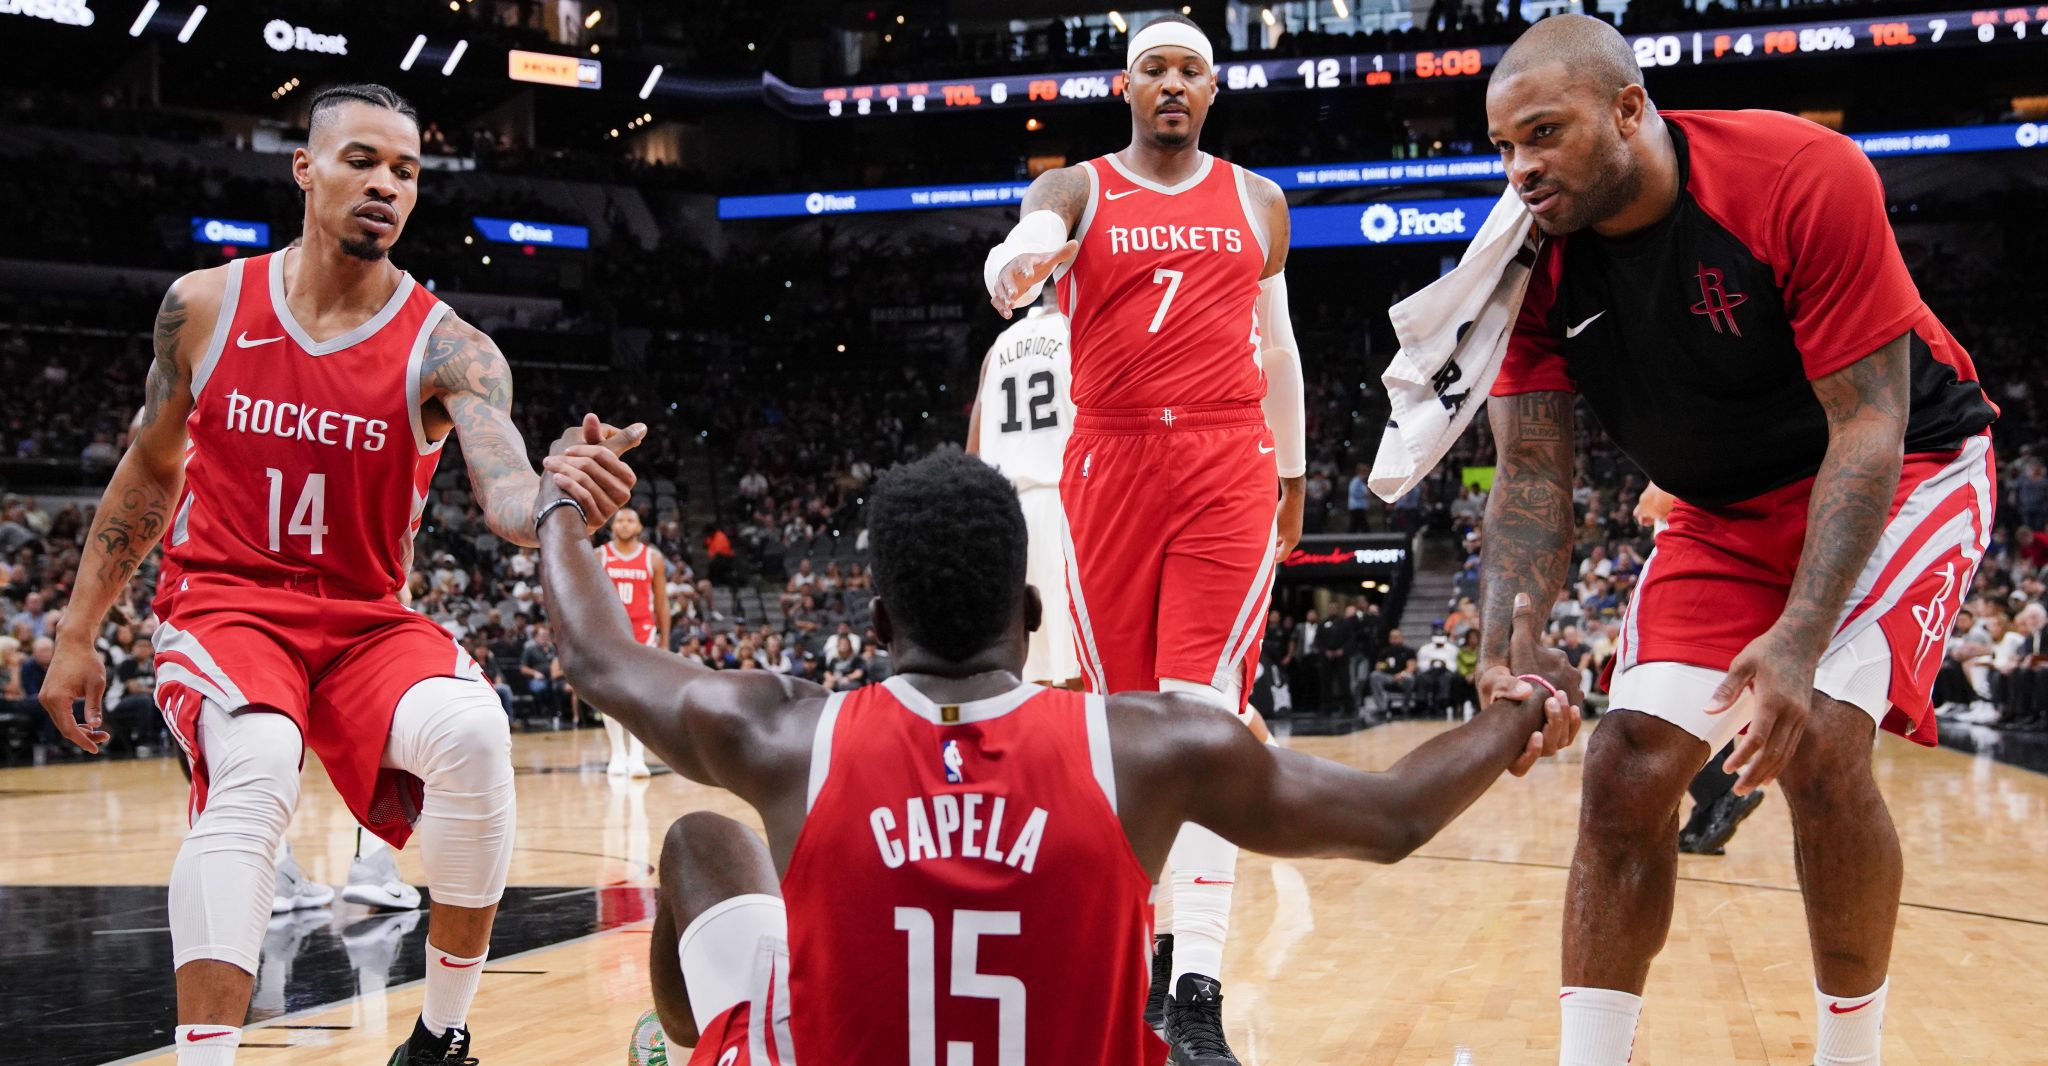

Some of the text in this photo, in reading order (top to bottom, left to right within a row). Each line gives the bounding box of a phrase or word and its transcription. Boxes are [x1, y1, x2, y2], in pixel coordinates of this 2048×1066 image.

[1633, 35, 1681, 67] 20
[1713, 34, 1731, 58] F
[1734, 33, 1753, 56] 4
[1799, 26, 1855, 52] 50%
[1928, 19, 1948, 43] 7
[1060, 76, 1109, 99] 40%
[1227, 64, 1268, 90] SA
[1297, 58, 1341, 89] 12
[1106, 224, 1243, 256] ROCKETS
[1399, 207, 1466, 236] Frost
[1147, 268, 1184, 333] 7
[999, 336, 1063, 369] ALDRIDGE
[224, 388, 389, 452] ROCKETS
[1000, 370, 1058, 433] 12
[266, 467, 329, 555] 14
[869, 793, 1049, 874] CAPELA
[894, 906, 1027, 1066] 15
